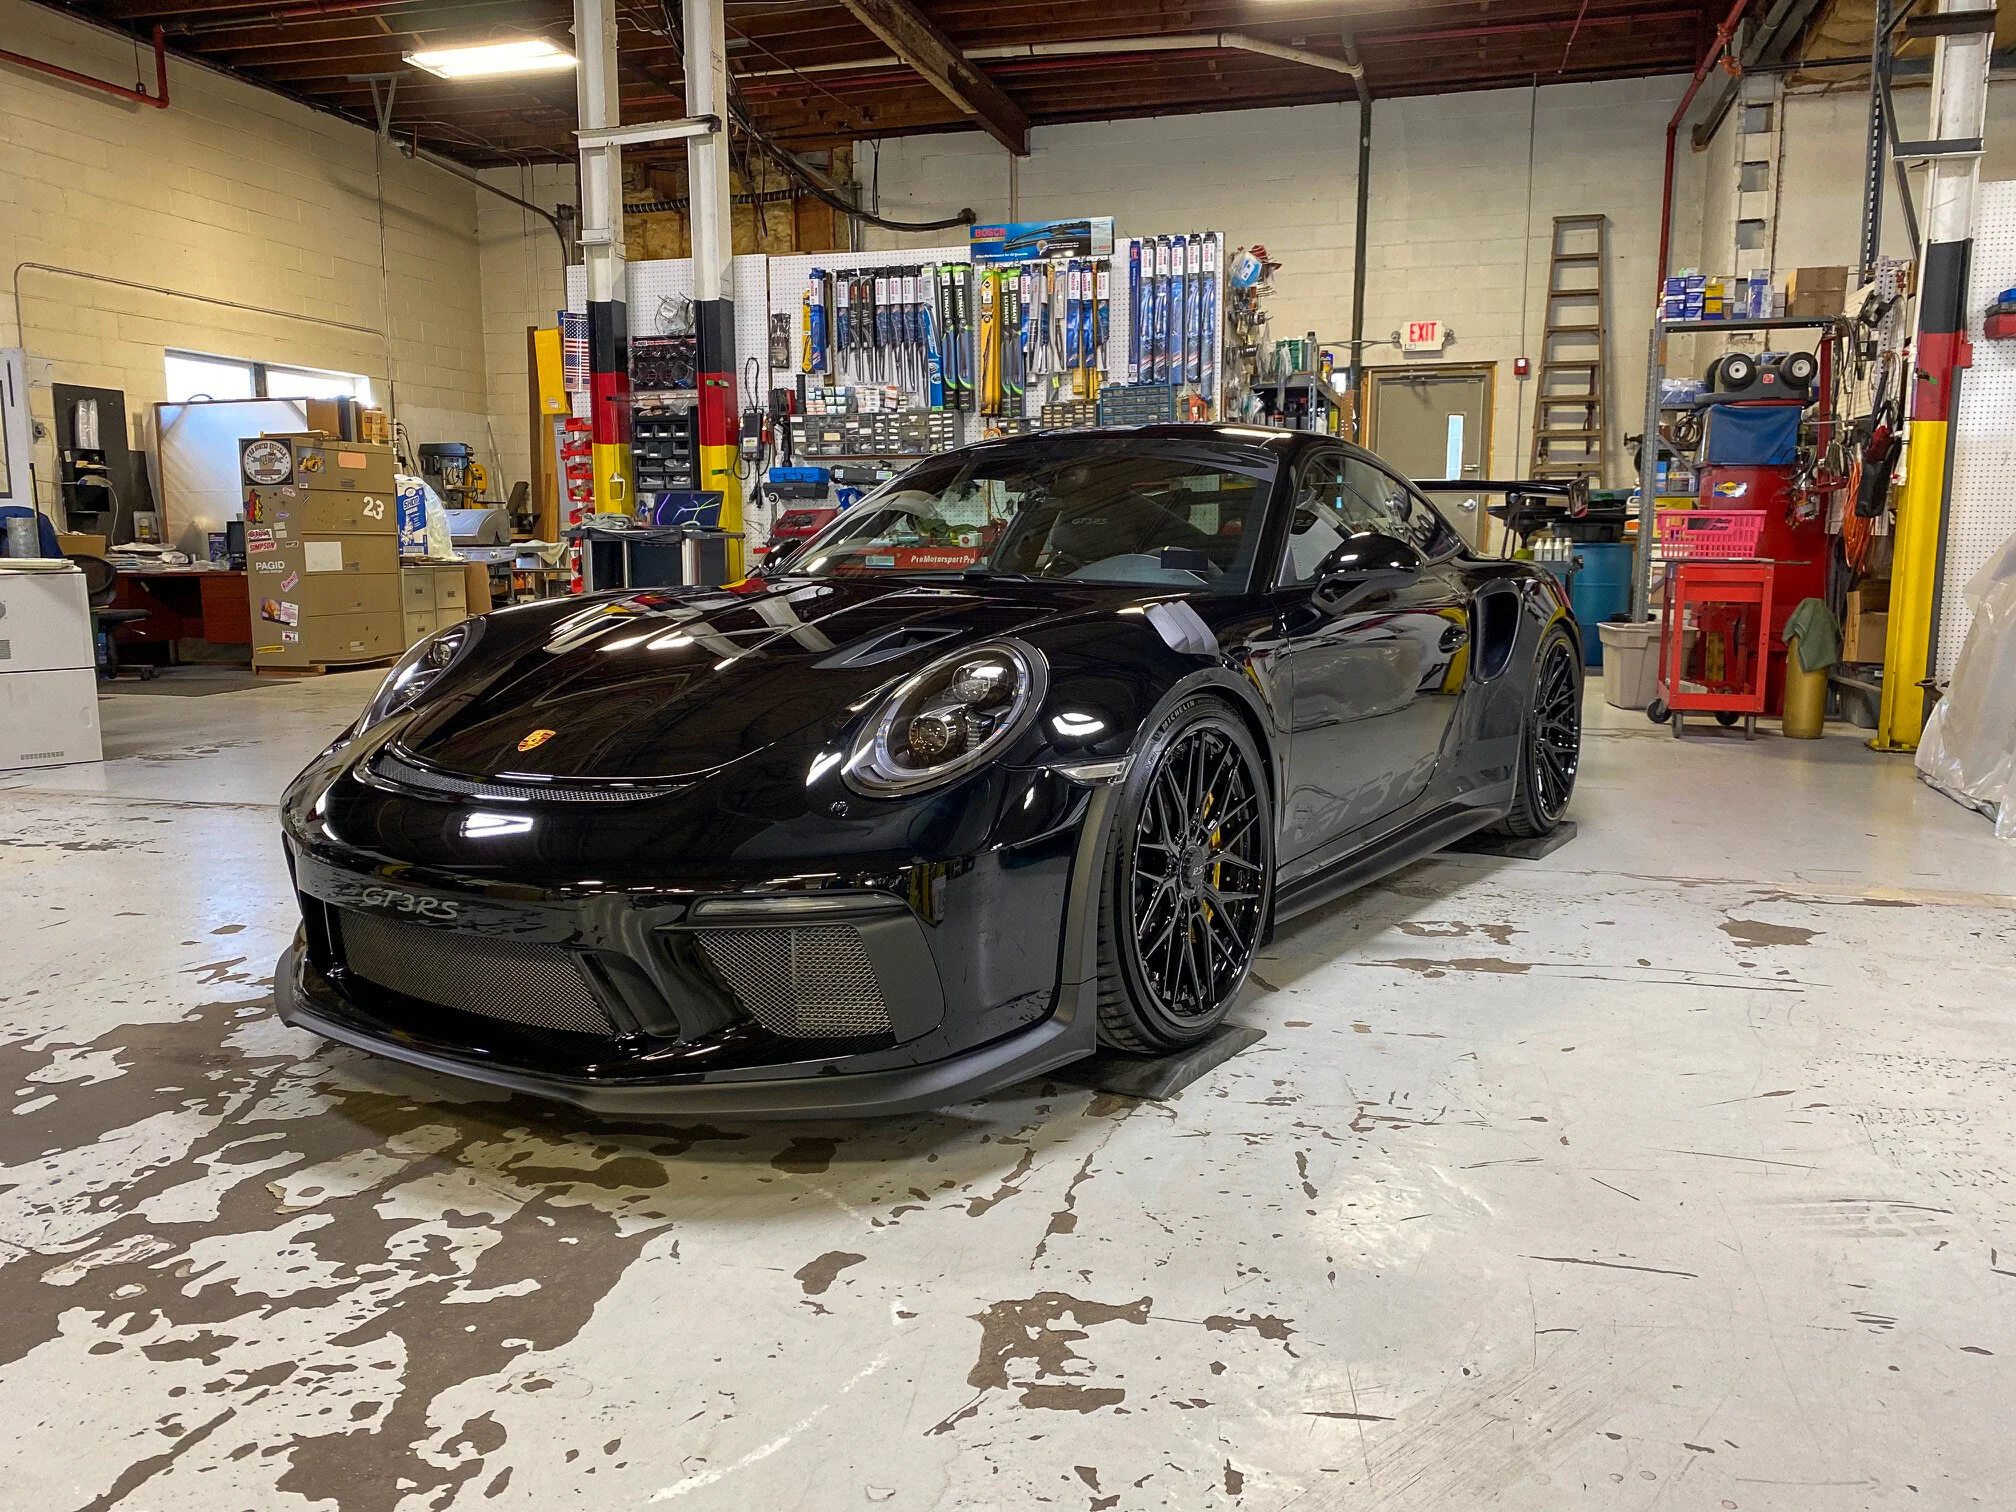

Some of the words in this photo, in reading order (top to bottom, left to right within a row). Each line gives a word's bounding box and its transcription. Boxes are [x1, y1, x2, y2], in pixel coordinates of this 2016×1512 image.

[975, 228, 1006, 238] BOSCH
[1410, 322, 1436, 342] EXIT
[363, 496, 384, 520] 23
[250, 542, 275, 551] SIMPSON
[256, 561, 285, 570] PAGID
[1161, 699, 1195, 731] MICHELIN
